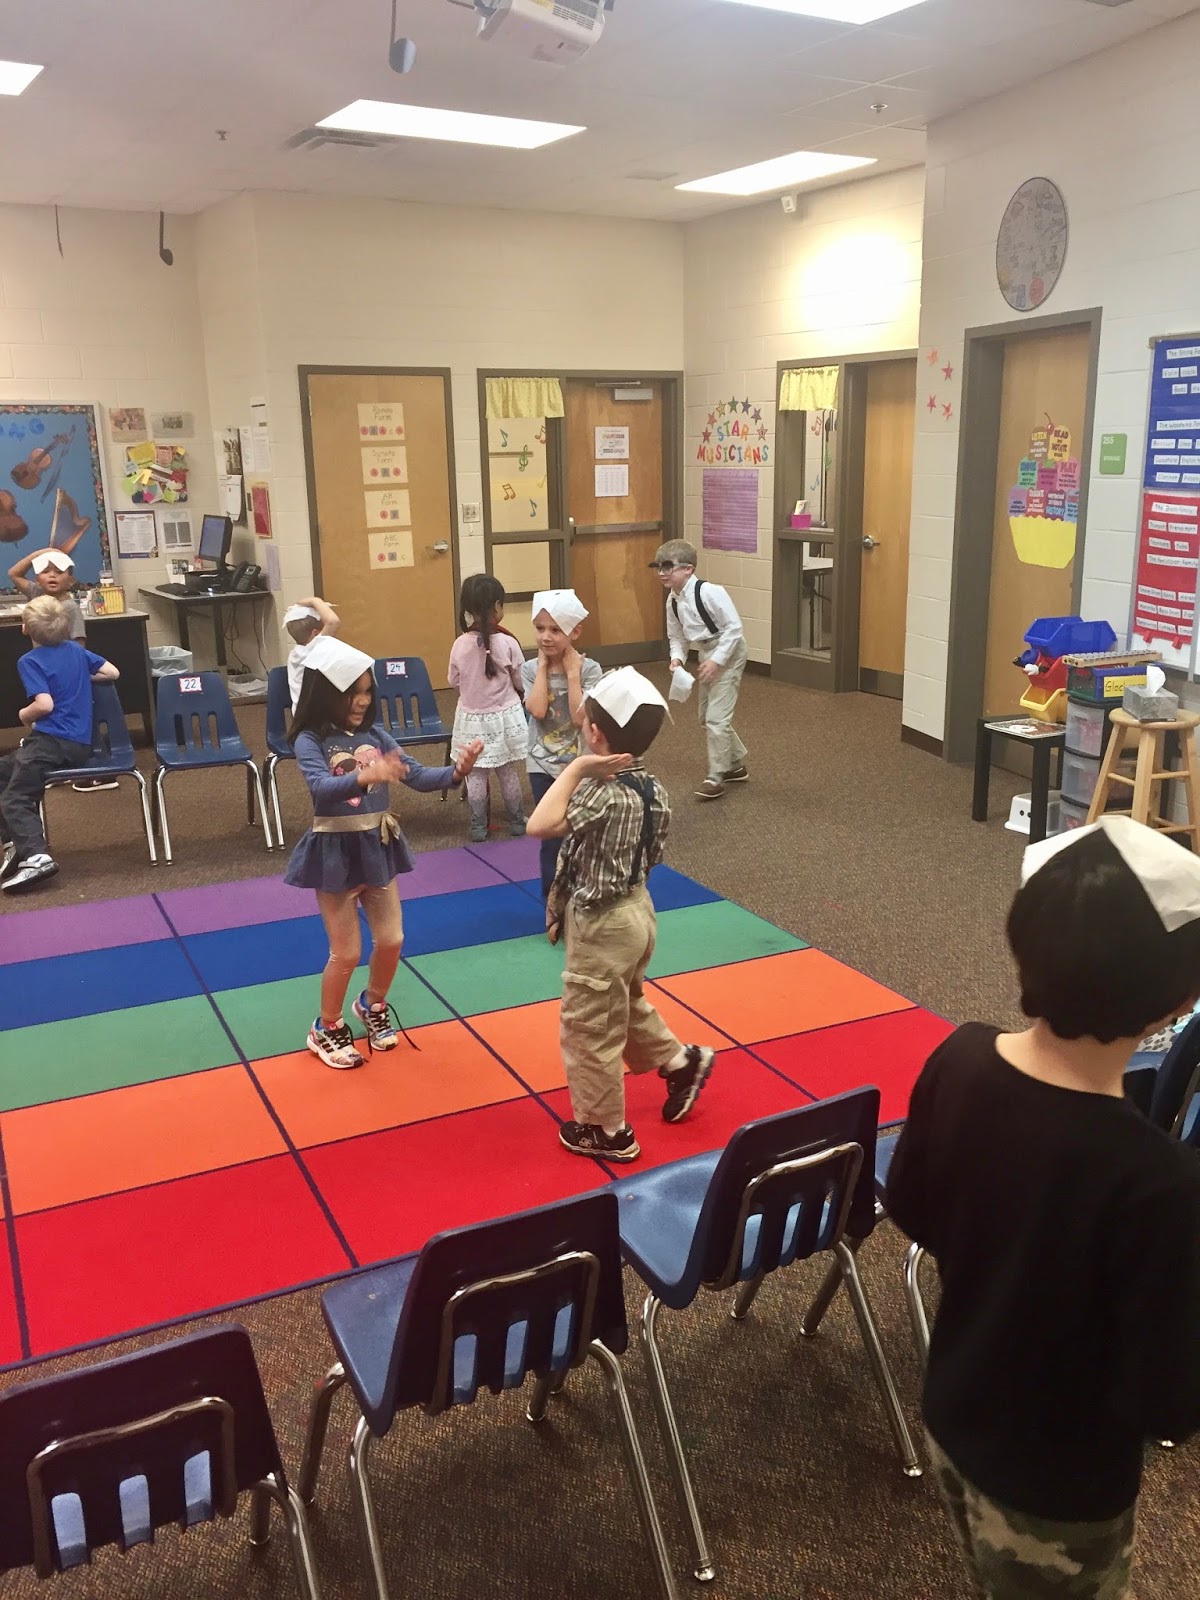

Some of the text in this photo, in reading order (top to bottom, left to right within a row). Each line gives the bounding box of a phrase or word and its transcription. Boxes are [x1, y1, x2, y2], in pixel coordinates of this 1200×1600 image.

[717, 420, 749, 442] STAR
[696, 444, 769, 464] MUSICIANS
[184, 679, 196, 690] 22
